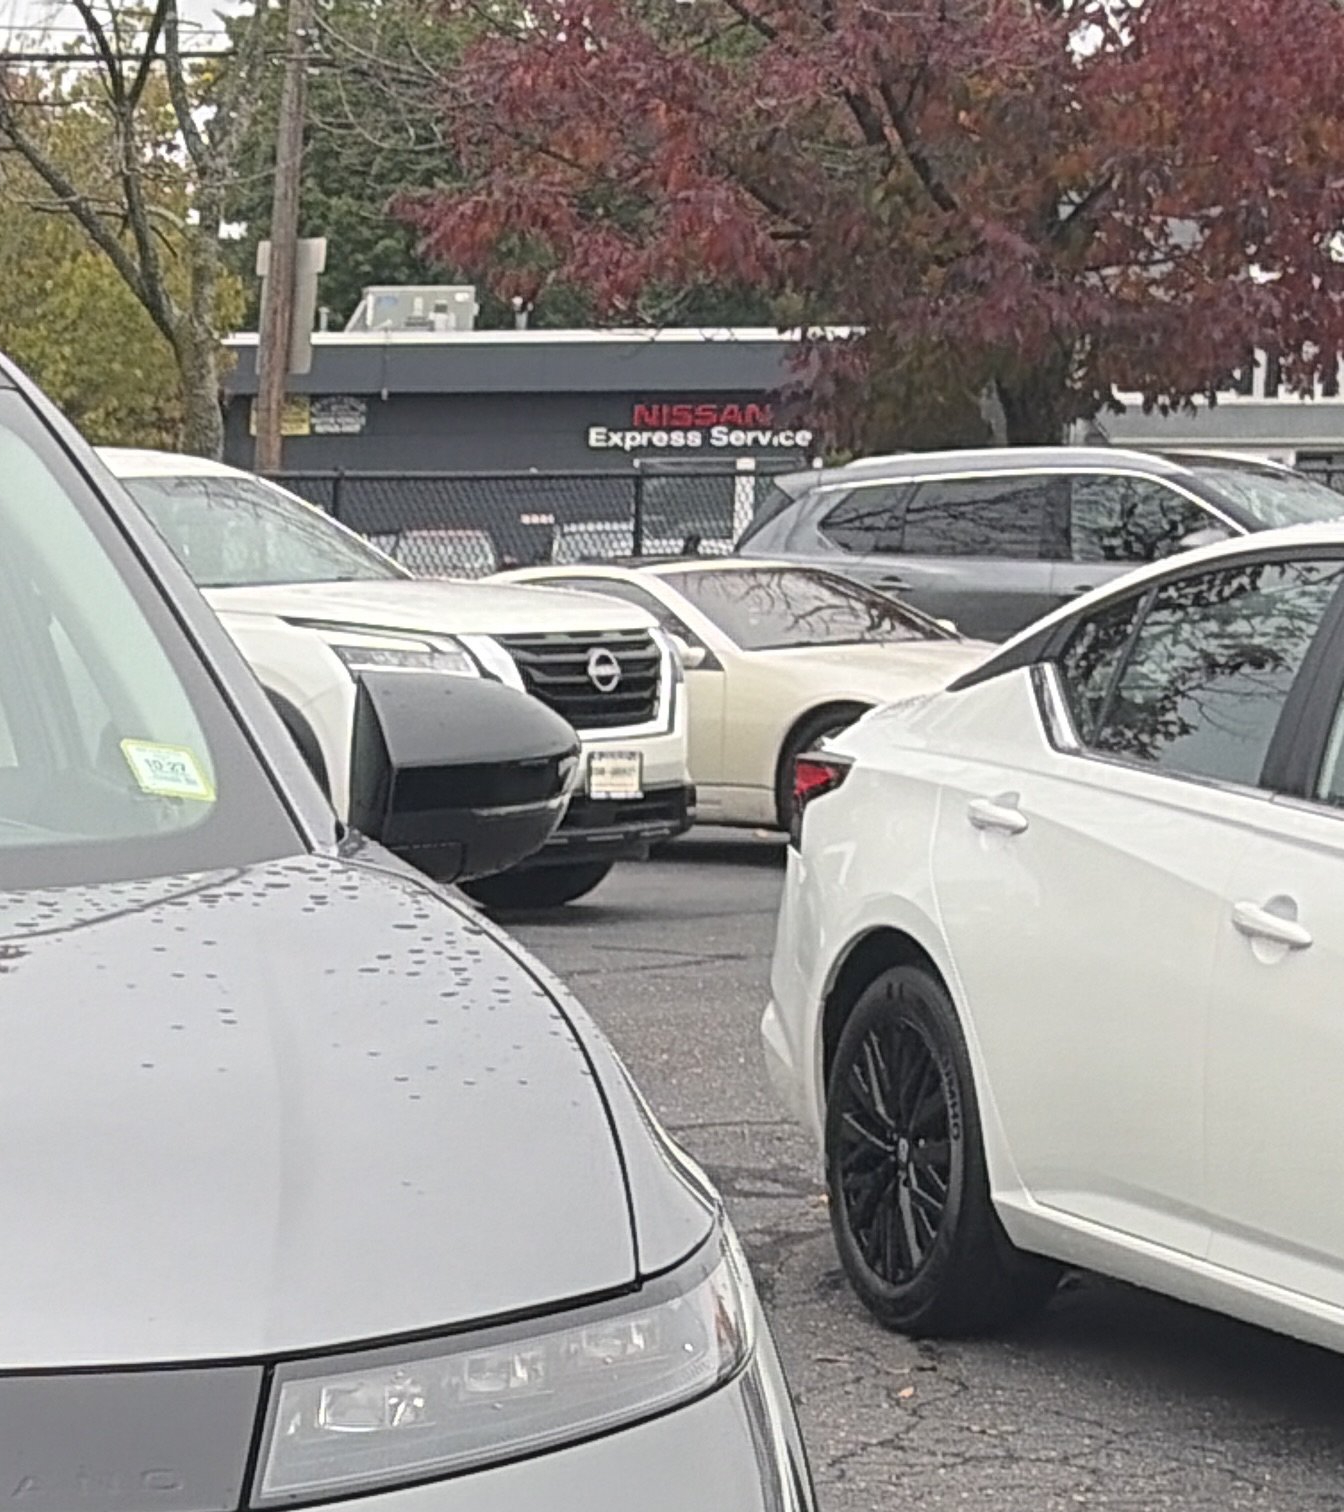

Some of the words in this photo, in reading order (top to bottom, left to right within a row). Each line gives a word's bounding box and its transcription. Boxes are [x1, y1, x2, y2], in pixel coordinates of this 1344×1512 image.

[632, 403, 775, 428] NISSAN
[588, 426, 702, 451] Express
[710, 425, 813, 447] Service
